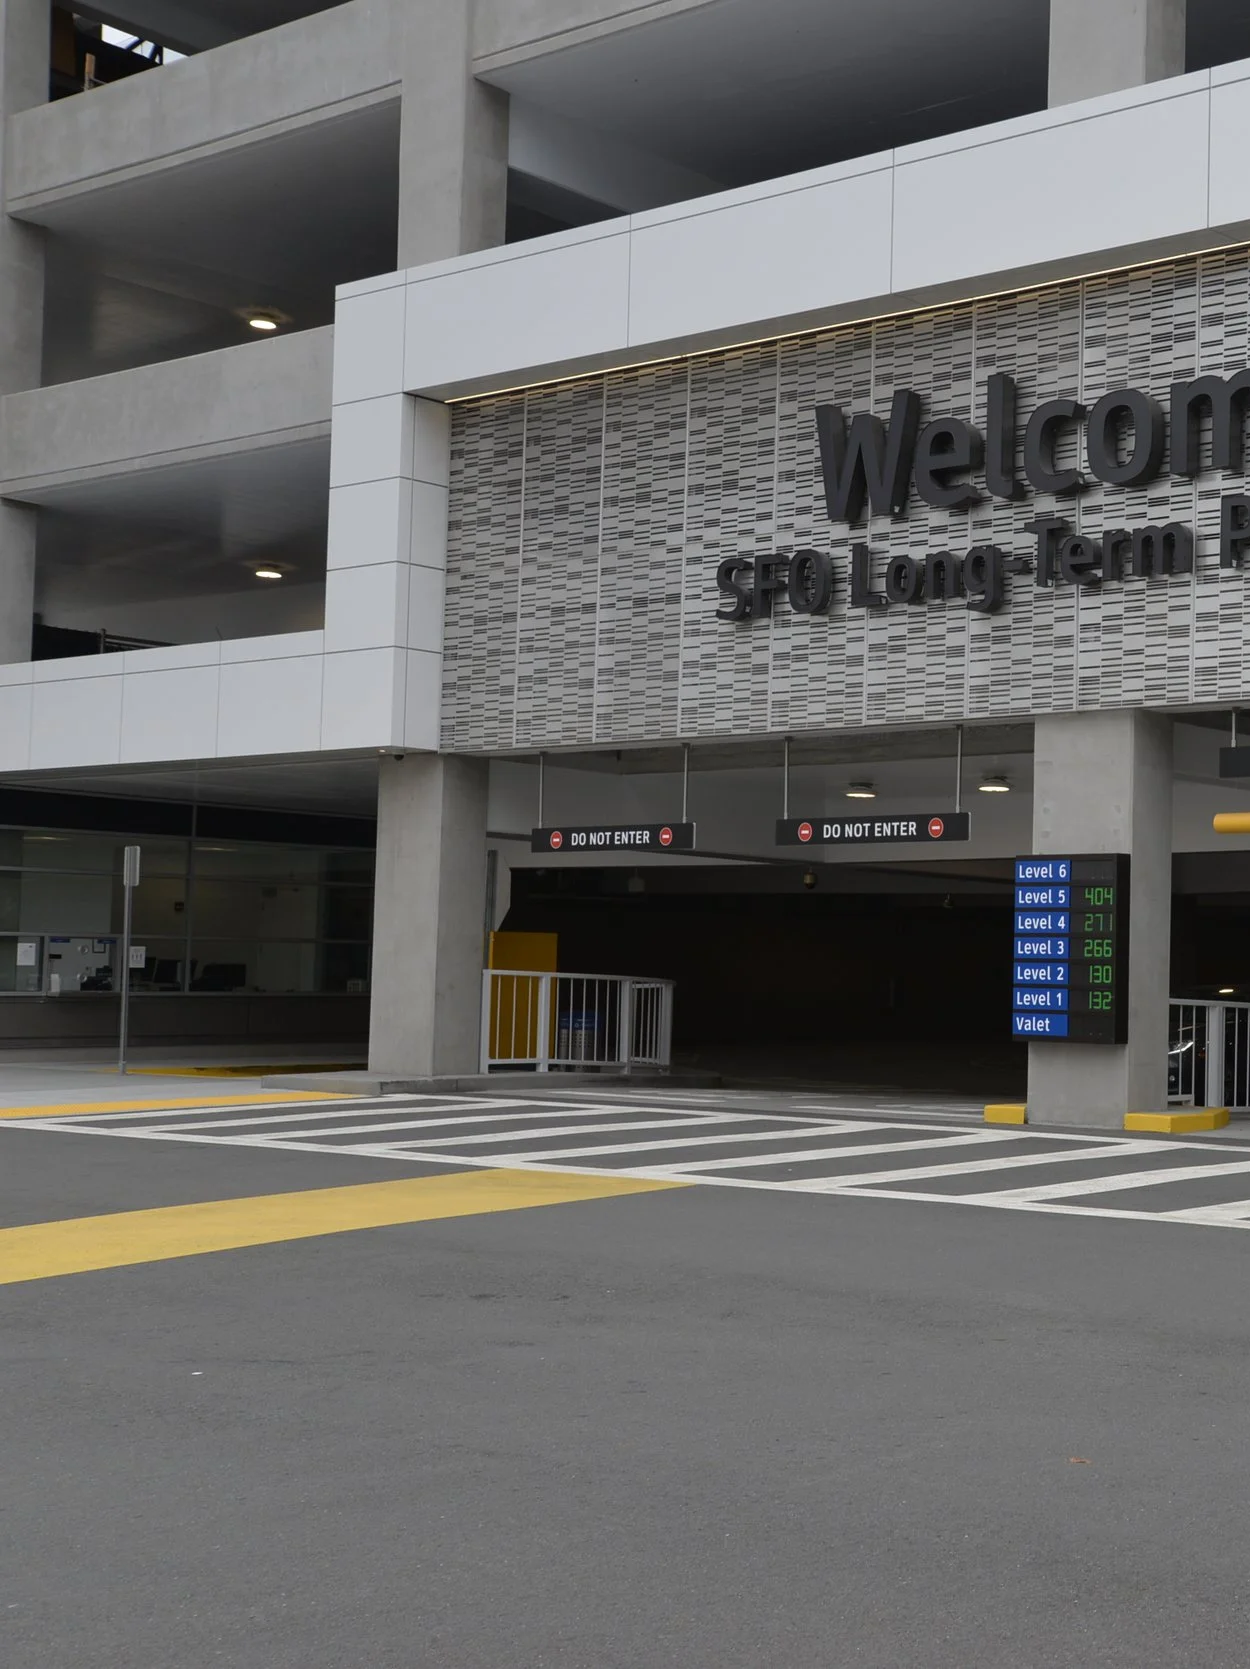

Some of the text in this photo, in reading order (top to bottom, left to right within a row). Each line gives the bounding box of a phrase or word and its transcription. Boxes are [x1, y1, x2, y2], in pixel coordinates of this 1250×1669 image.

[715, 548, 831, 622] SFO
[852, 517, 1192, 613] Long-Term
[571, 830, 650, 846] DO NOT ENTER
[823, 821, 917, 839] DO NOT ENTER
[1018, 863, 1067, 879] Level 6
[1018, 889, 1066, 904] Level 5
[1084, 887, 1113, 906] 404
[1017, 914, 1066, 930] Level 4
[1084, 914, 1113, 932] 271
[1017, 940, 1065, 955] Level 3
[1084, 939, 1112, 958] 266
[1017, 965, 1064, 981] Level 2
[1089, 965, 1112, 983] 130
[1016, 991, 1062, 1006] Level 1
[1089, 991, 1112, 1010] 132
[1015, 1016, 1050, 1032] Valet
